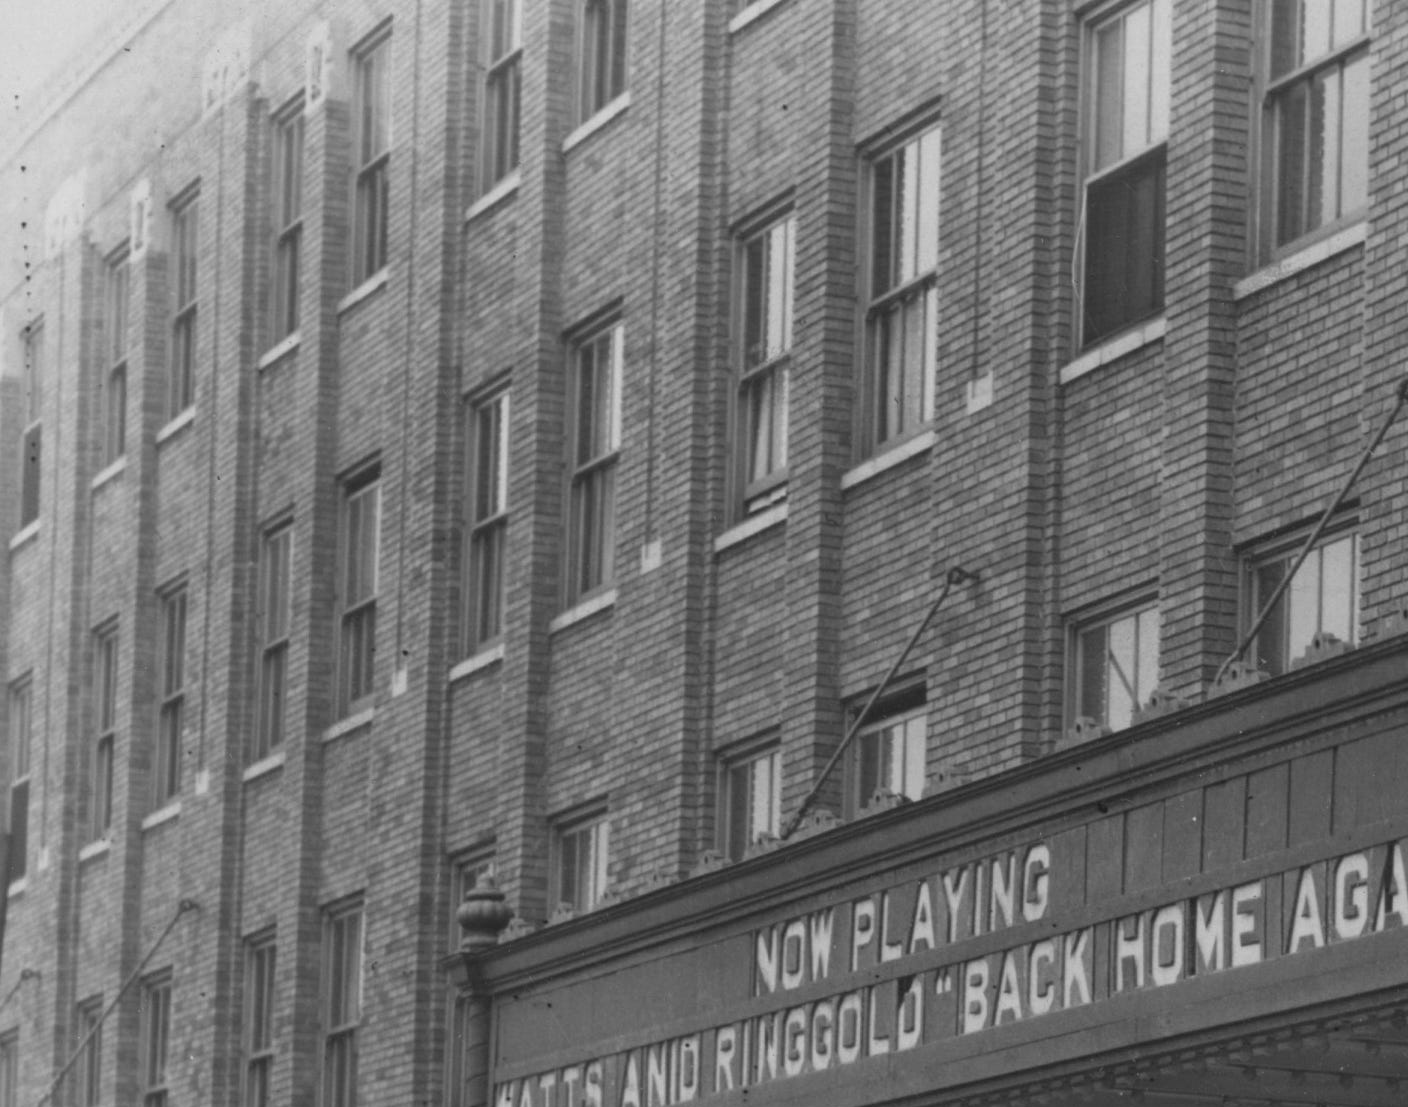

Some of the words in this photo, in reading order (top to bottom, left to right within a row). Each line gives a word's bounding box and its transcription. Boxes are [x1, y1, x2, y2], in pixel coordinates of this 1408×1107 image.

[714, 984, 922, 1092] RINGGOLD
[1115, 882, 1262, 993] HOME
[755, 908, 834, 997] NOW
[849, 843, 1050, 973] PLAYING
